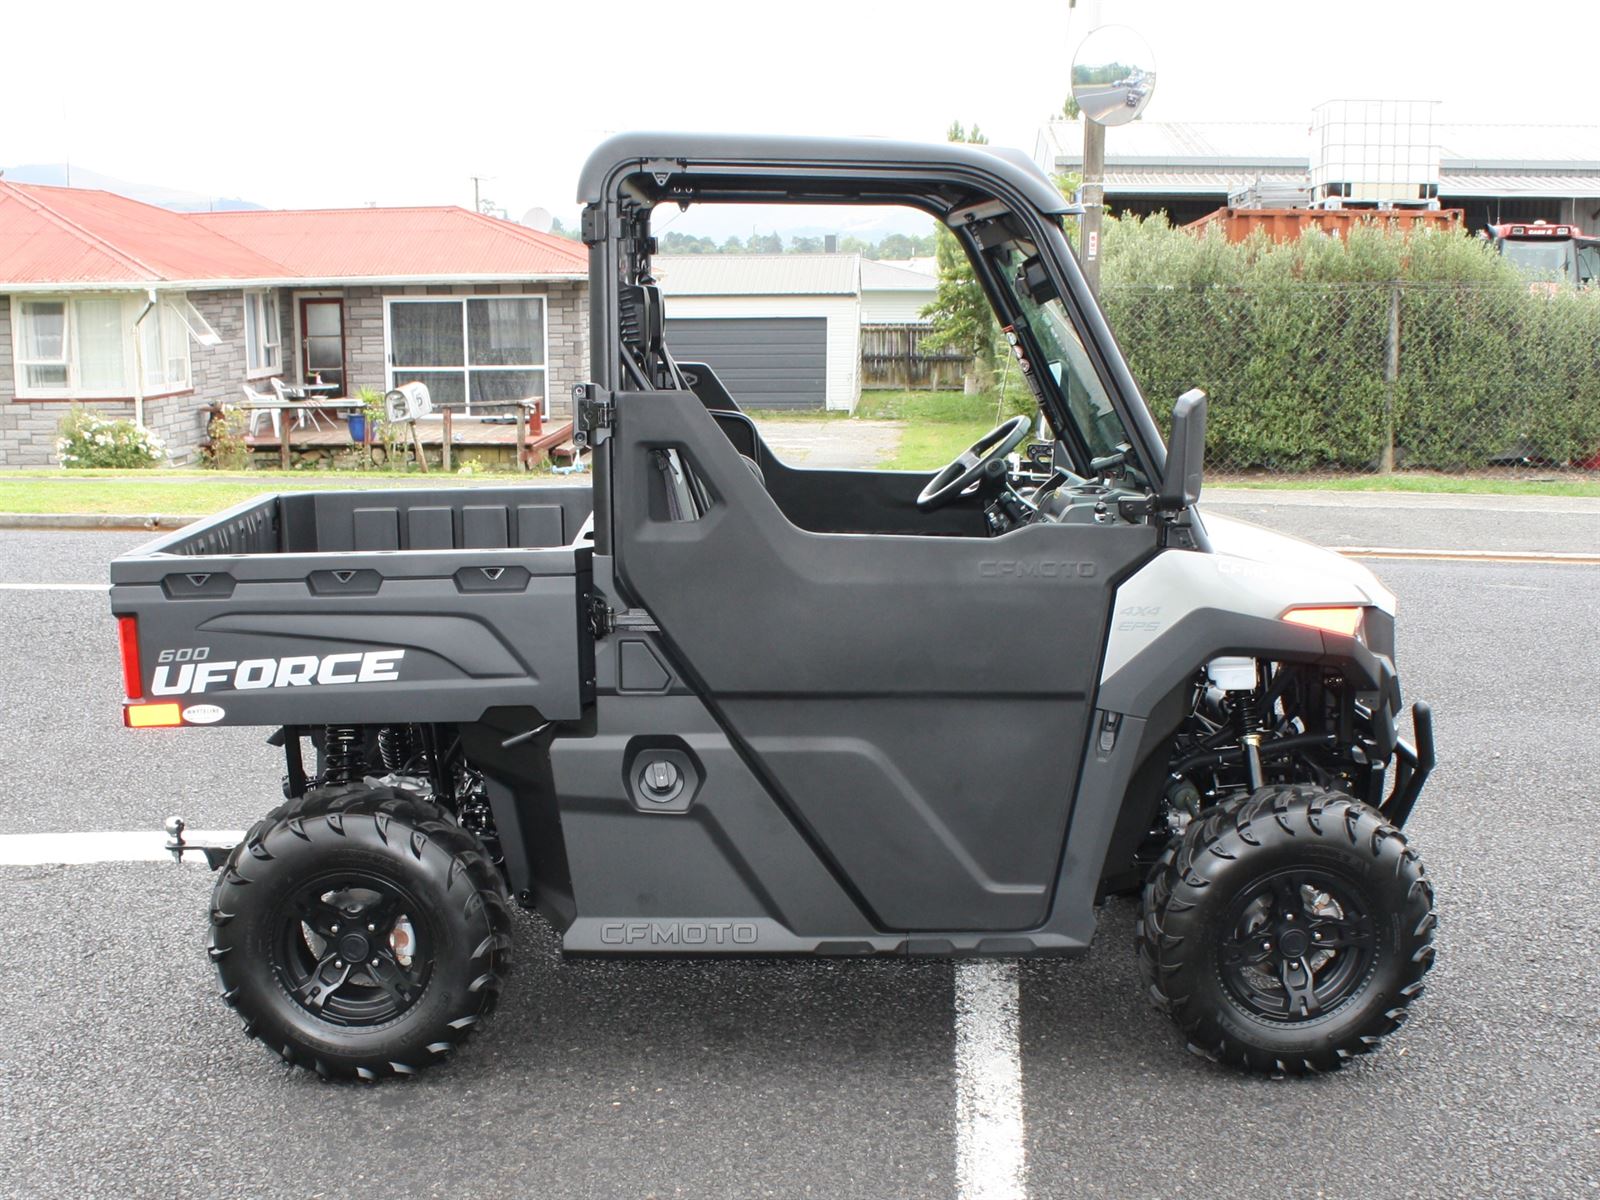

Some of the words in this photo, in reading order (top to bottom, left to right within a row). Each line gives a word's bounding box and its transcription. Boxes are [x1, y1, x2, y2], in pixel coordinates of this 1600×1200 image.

[979, 560, 1098, 578] CFMOTO
[1118, 622, 1161, 632] EPS
[158, 647, 210, 663] 600
[151, 649, 406, 696] UFORCE
[600, 923, 758, 944] CFMOTO
